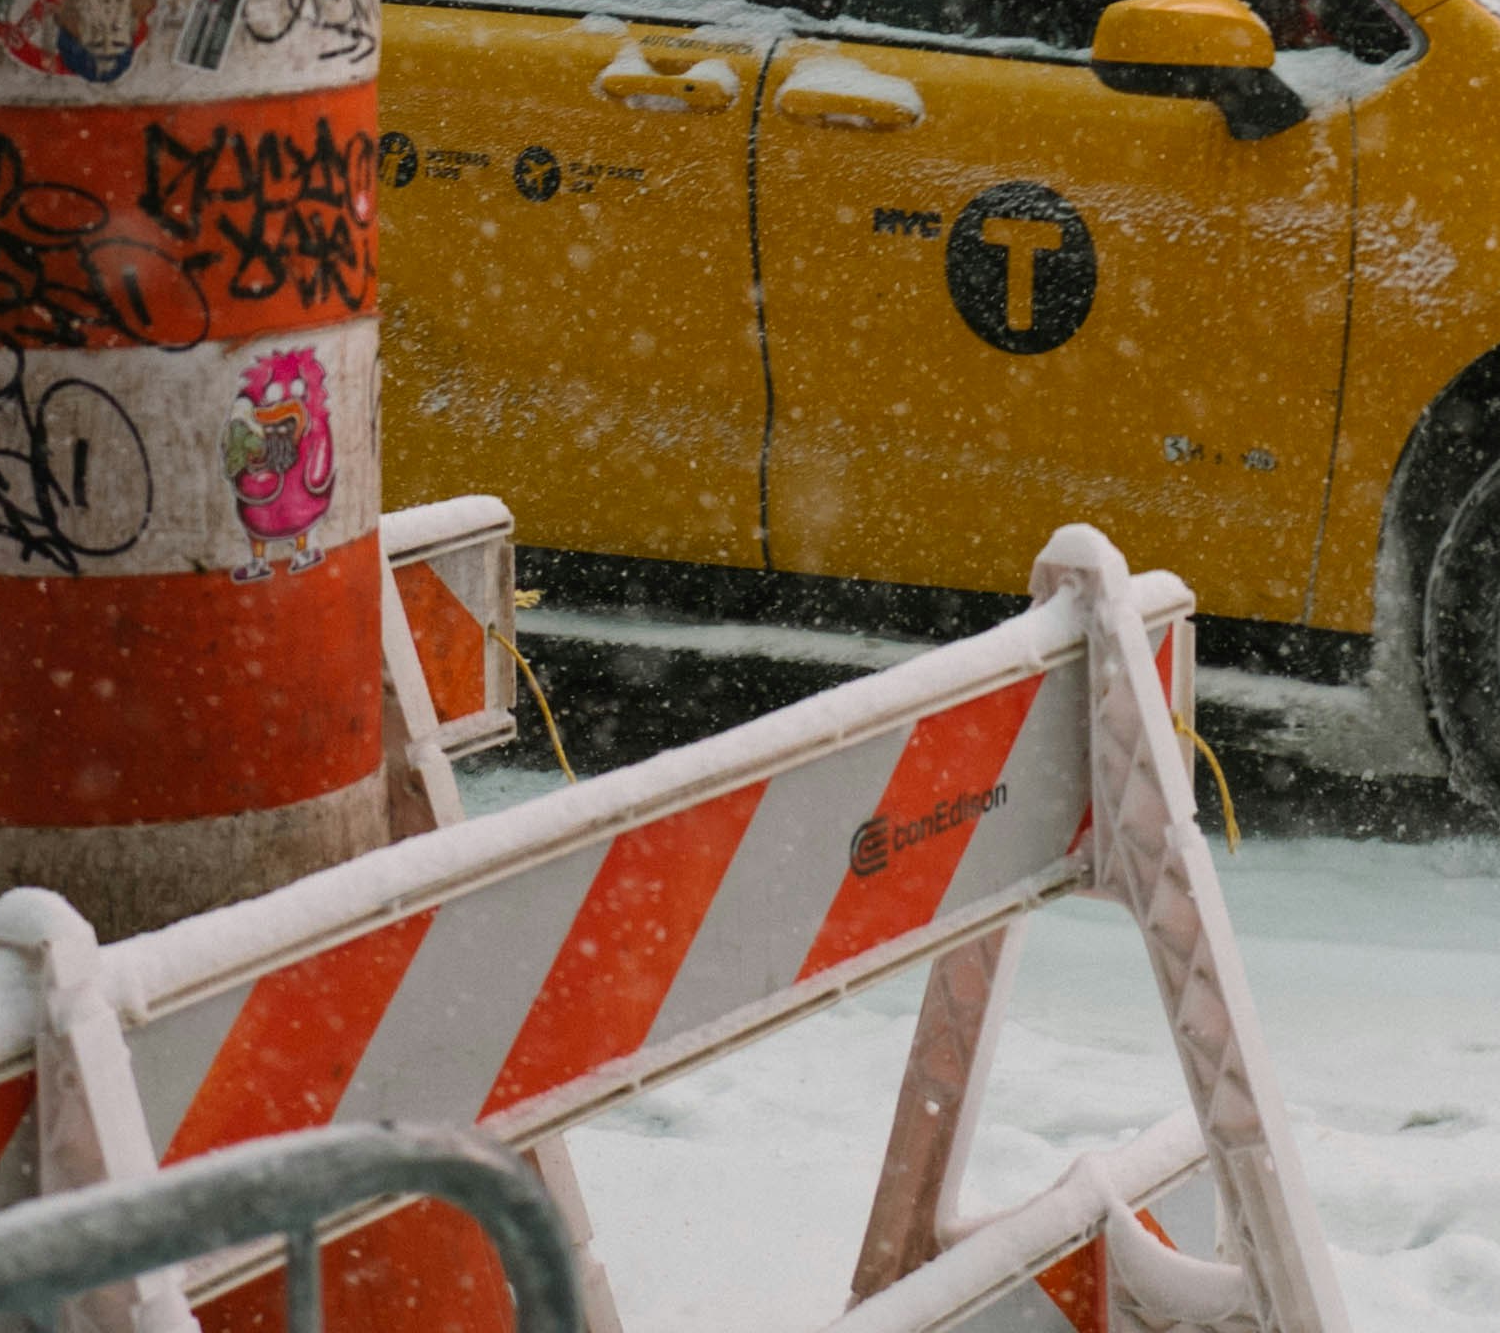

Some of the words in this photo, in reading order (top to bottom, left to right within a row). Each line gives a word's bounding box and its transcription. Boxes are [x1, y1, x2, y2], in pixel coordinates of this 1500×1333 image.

[872, 206, 943, 239] NYC
[982, 217, 1062, 331] T
[892, 781, 1008, 852] conEdison
